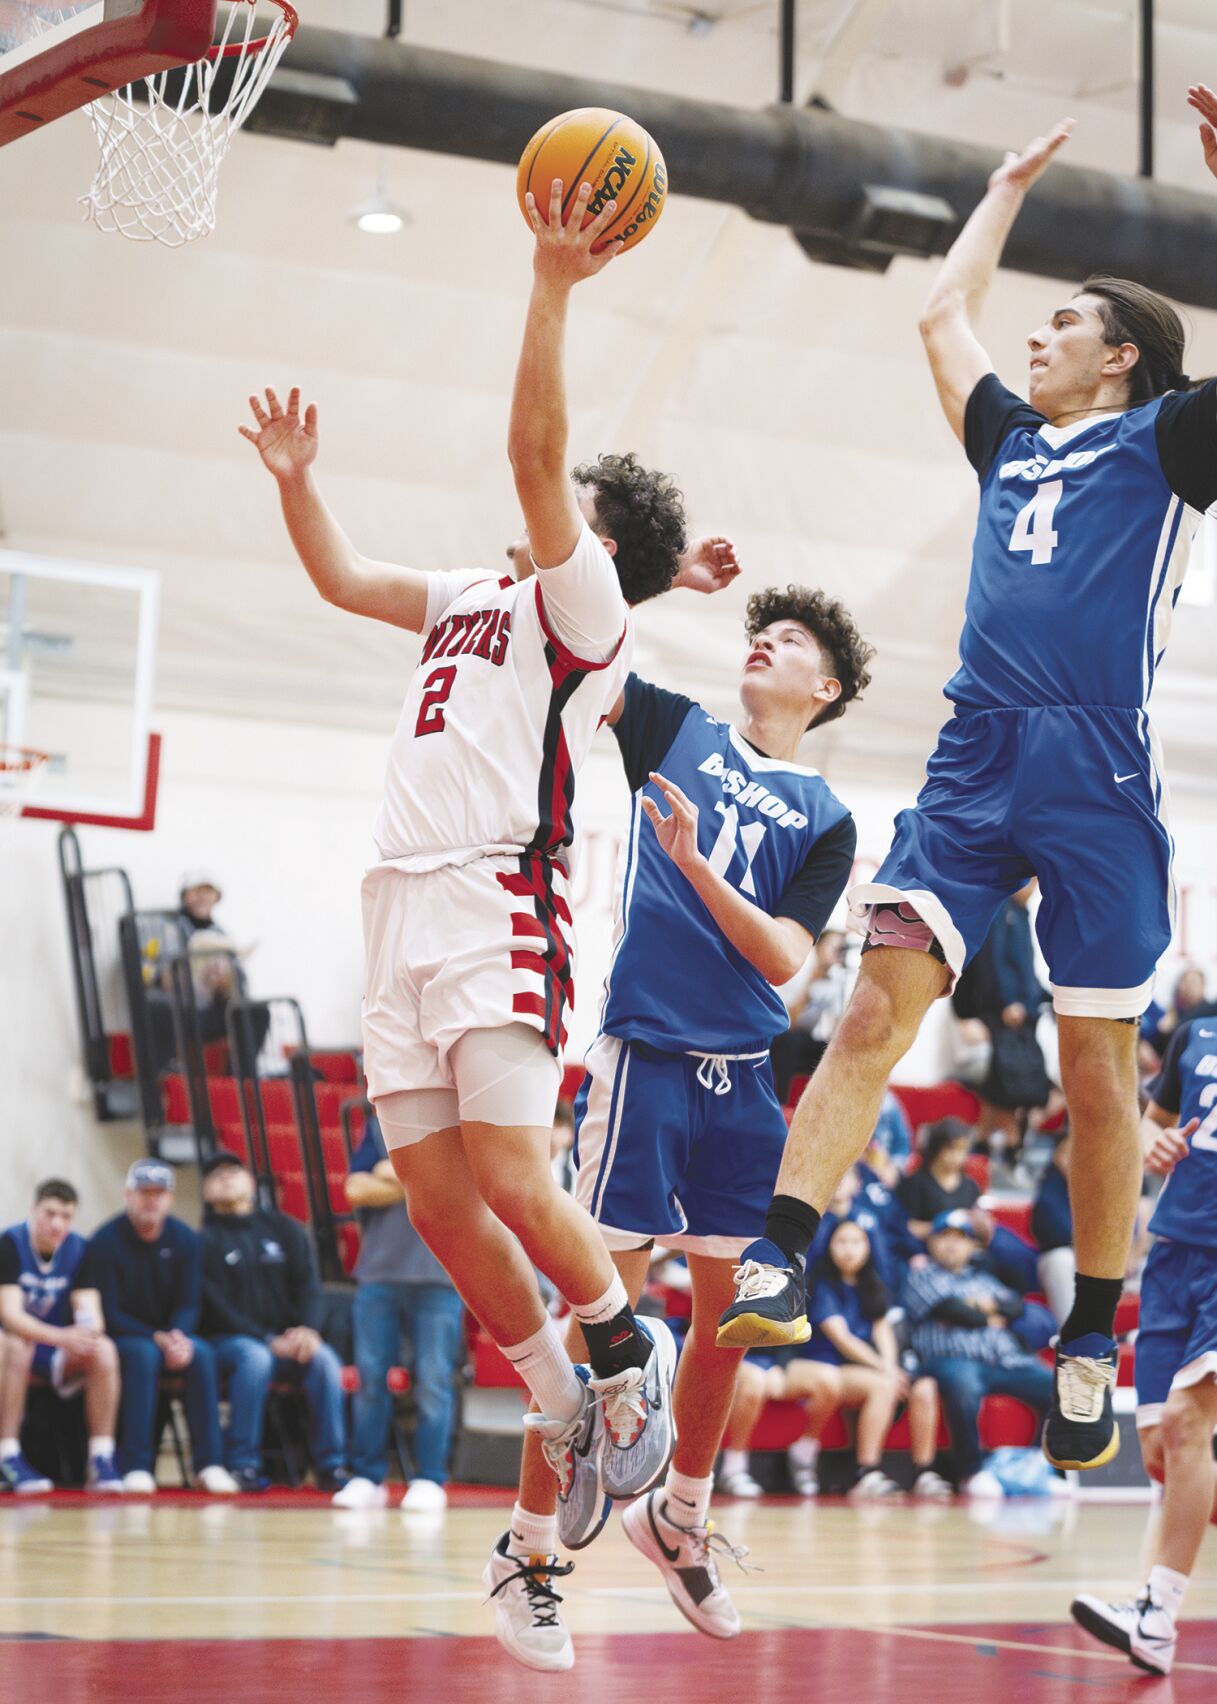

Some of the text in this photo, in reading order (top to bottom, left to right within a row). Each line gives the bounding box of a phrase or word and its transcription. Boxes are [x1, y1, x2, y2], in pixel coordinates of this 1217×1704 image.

[587, 147, 636, 216] NCAA
[1008, 479, 1063, 565] 4
[415, 664, 458, 738] 2
